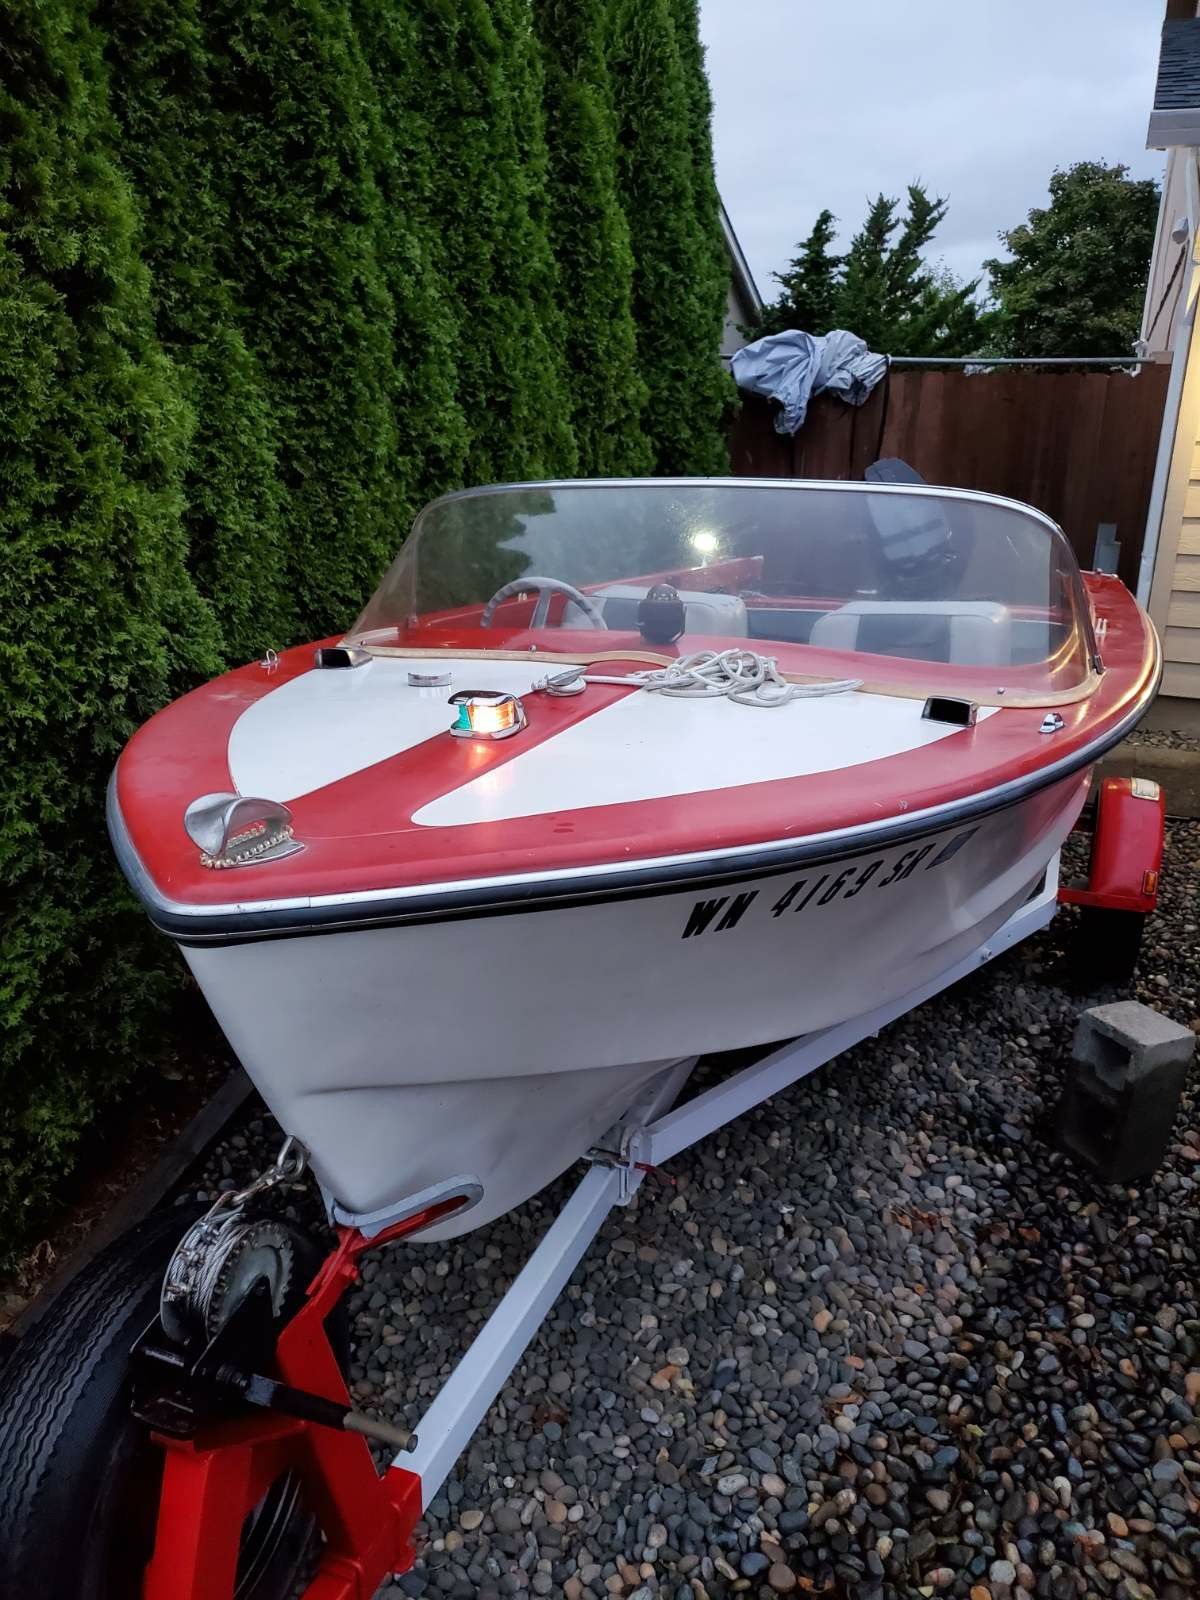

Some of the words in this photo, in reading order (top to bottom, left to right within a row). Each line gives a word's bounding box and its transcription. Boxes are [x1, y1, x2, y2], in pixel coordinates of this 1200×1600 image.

[681, 890, 760, 939] WN
[770, 859, 884, 918] 4169
[877, 842, 937, 887] SR
